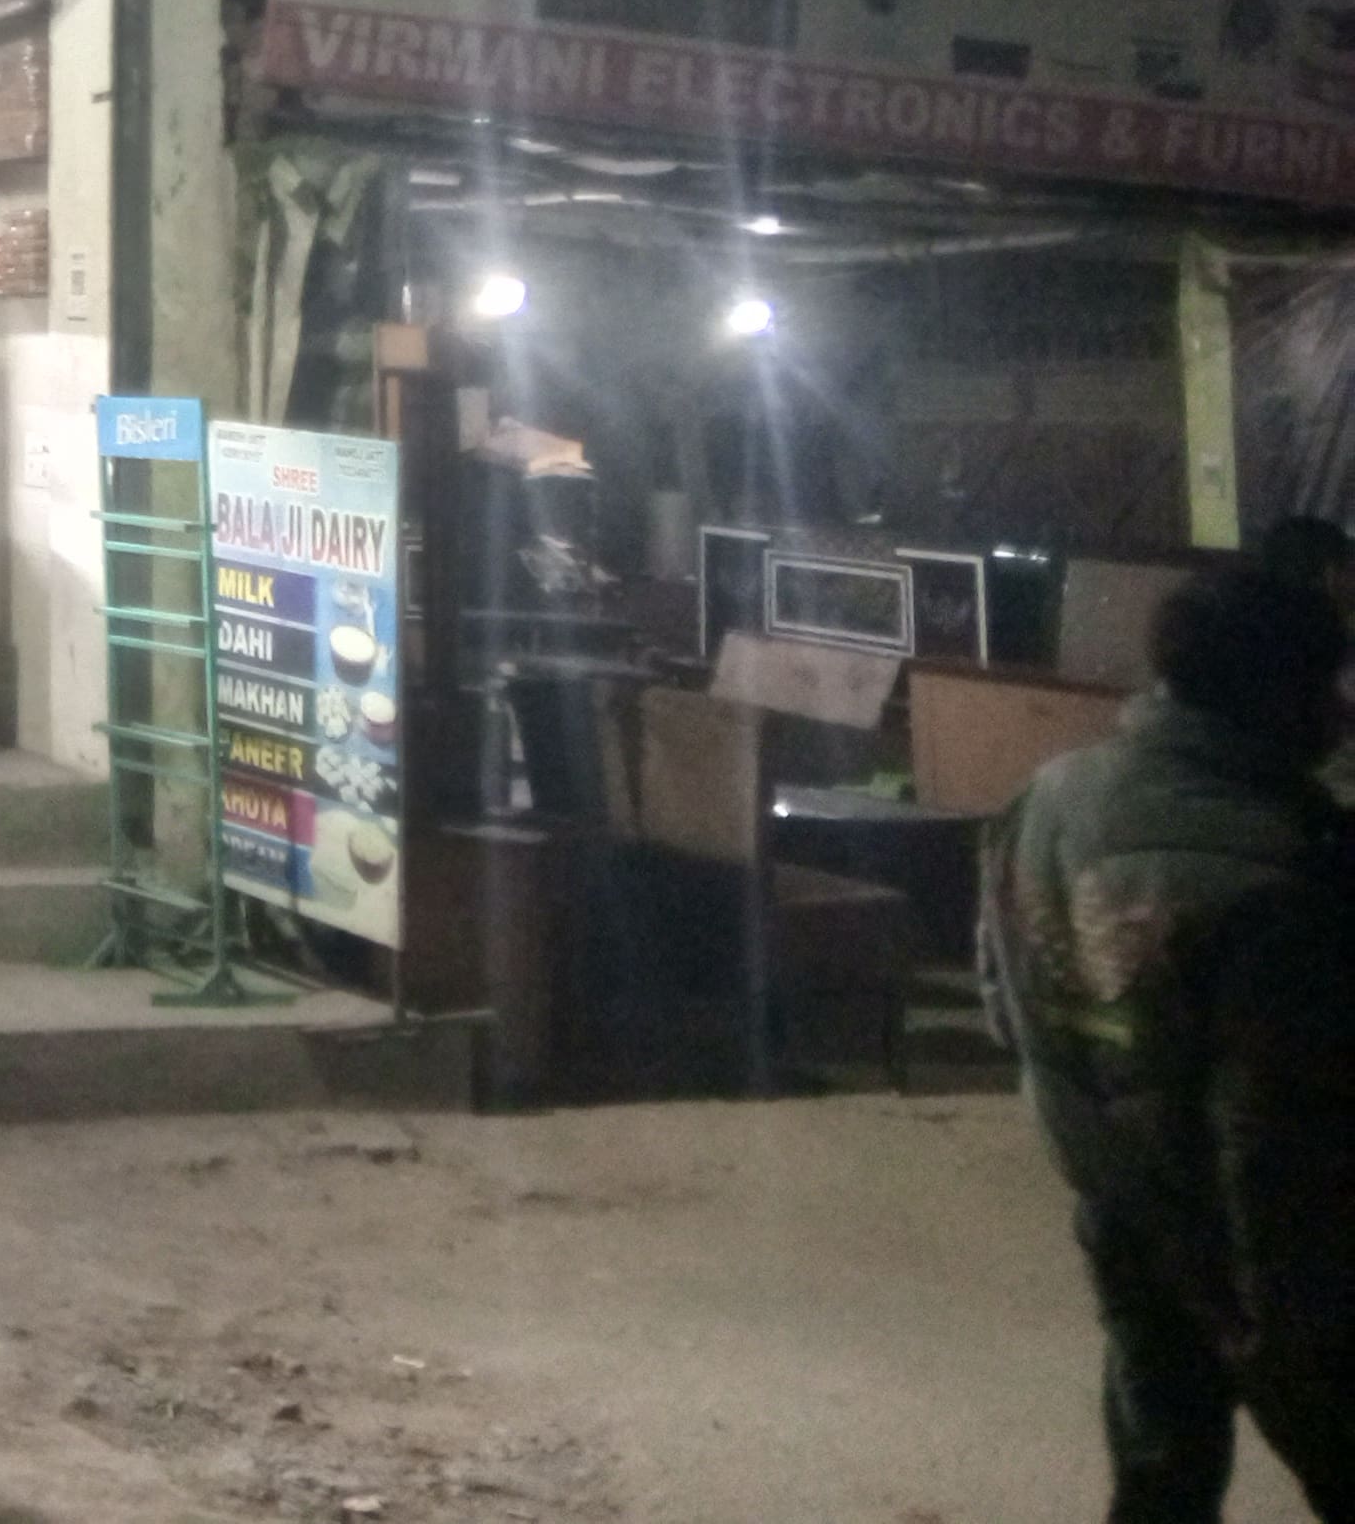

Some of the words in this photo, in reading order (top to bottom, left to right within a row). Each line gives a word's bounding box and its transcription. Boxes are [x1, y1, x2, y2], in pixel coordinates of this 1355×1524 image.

[299, 7, 606, 99] VIRMANI
[628, 50, 1080, 158] ELECTRONICS
[1101, 107, 1141, 161] &
[1162, 114, 1355, 192] FURNI
[114, 406, 179, 446] Bisleri
[272, 465, 319, 495] SHREE
[216, 492, 276, 553] BALA
[281, 504, 304, 560] JI
[309, 509, 387, 575] DAIRY
[217, 568, 276, 610] MILK
[217, 621, 274, 663] DAHI
[217, 674, 305, 727] MAKHAN
